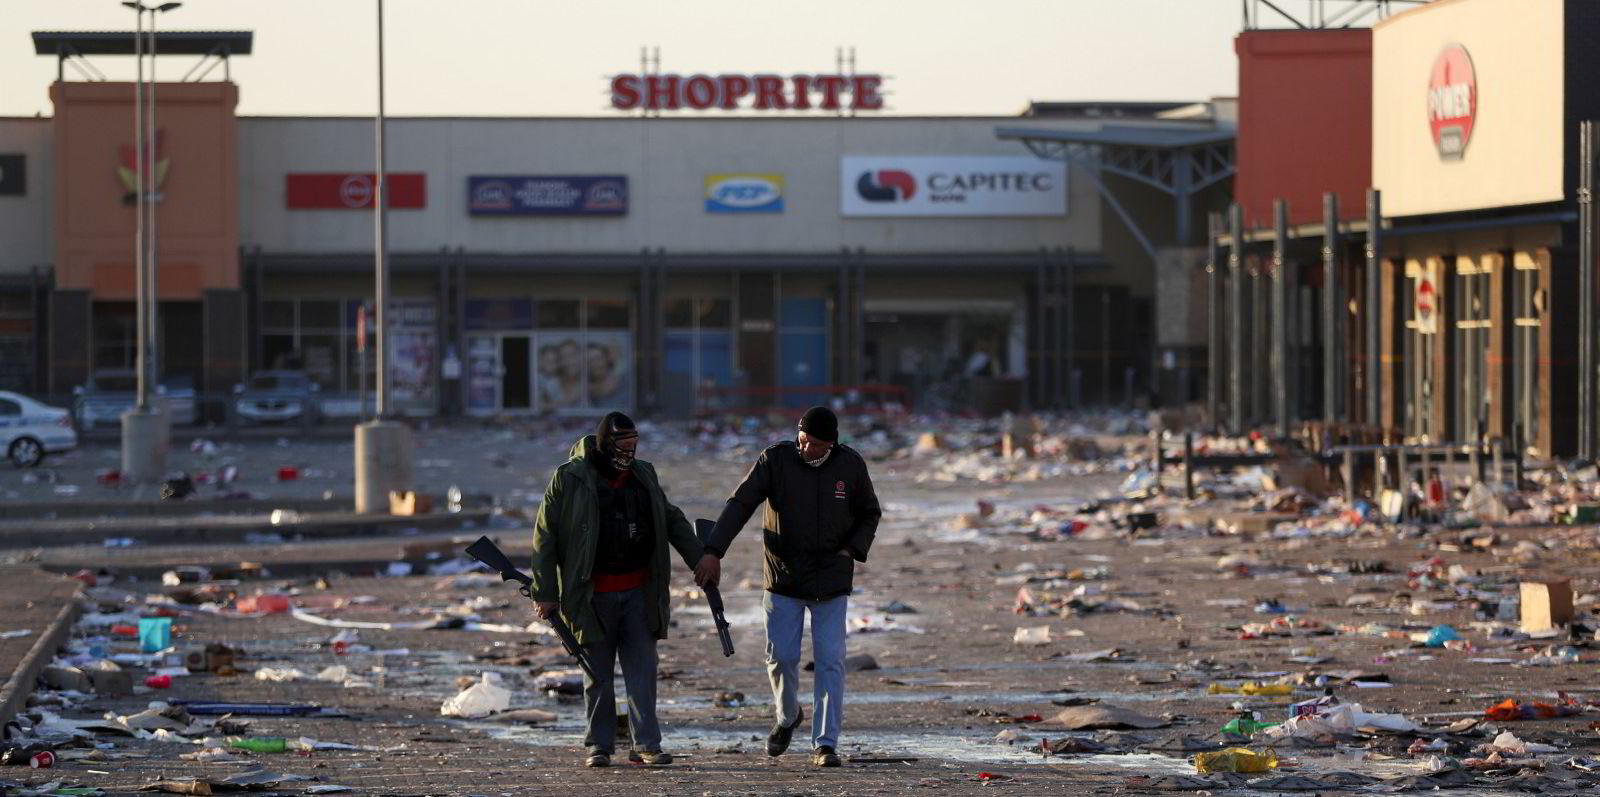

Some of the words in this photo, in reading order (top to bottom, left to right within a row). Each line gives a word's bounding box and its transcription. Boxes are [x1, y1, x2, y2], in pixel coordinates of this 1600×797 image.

[611, 74, 884, 110] SHOPRITE
[927, 173, 1053, 192] CAPITEC
[718, 185, 769, 200] PEP
